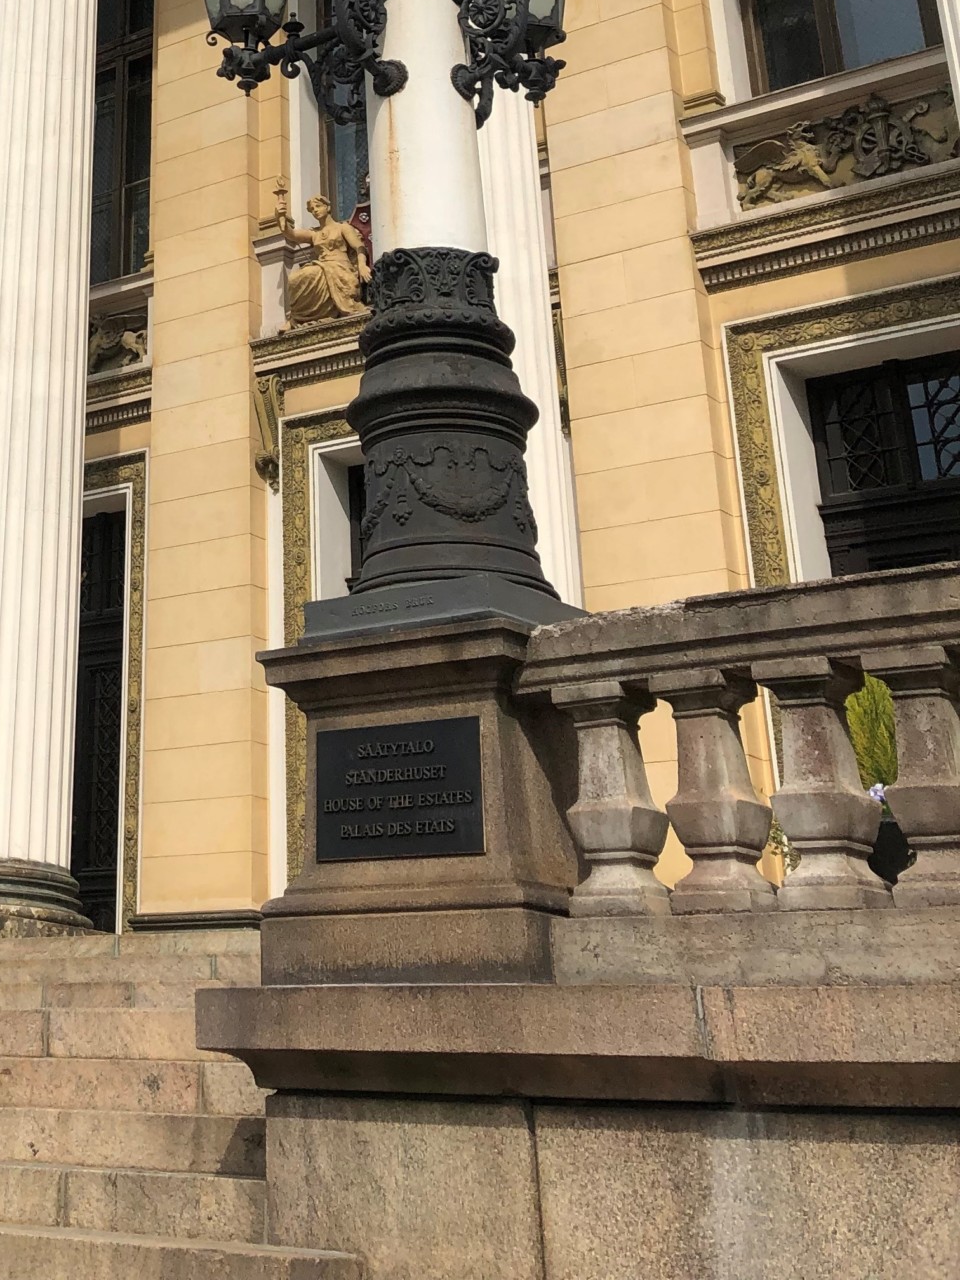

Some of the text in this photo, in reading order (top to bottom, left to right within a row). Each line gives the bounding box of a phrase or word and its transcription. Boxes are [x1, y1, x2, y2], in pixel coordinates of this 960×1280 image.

[324, 790, 473, 812] HOUSE OF THE ESTATES
[341, 822, 384, 838] PALAIS
[388, 821, 412, 835] DES
